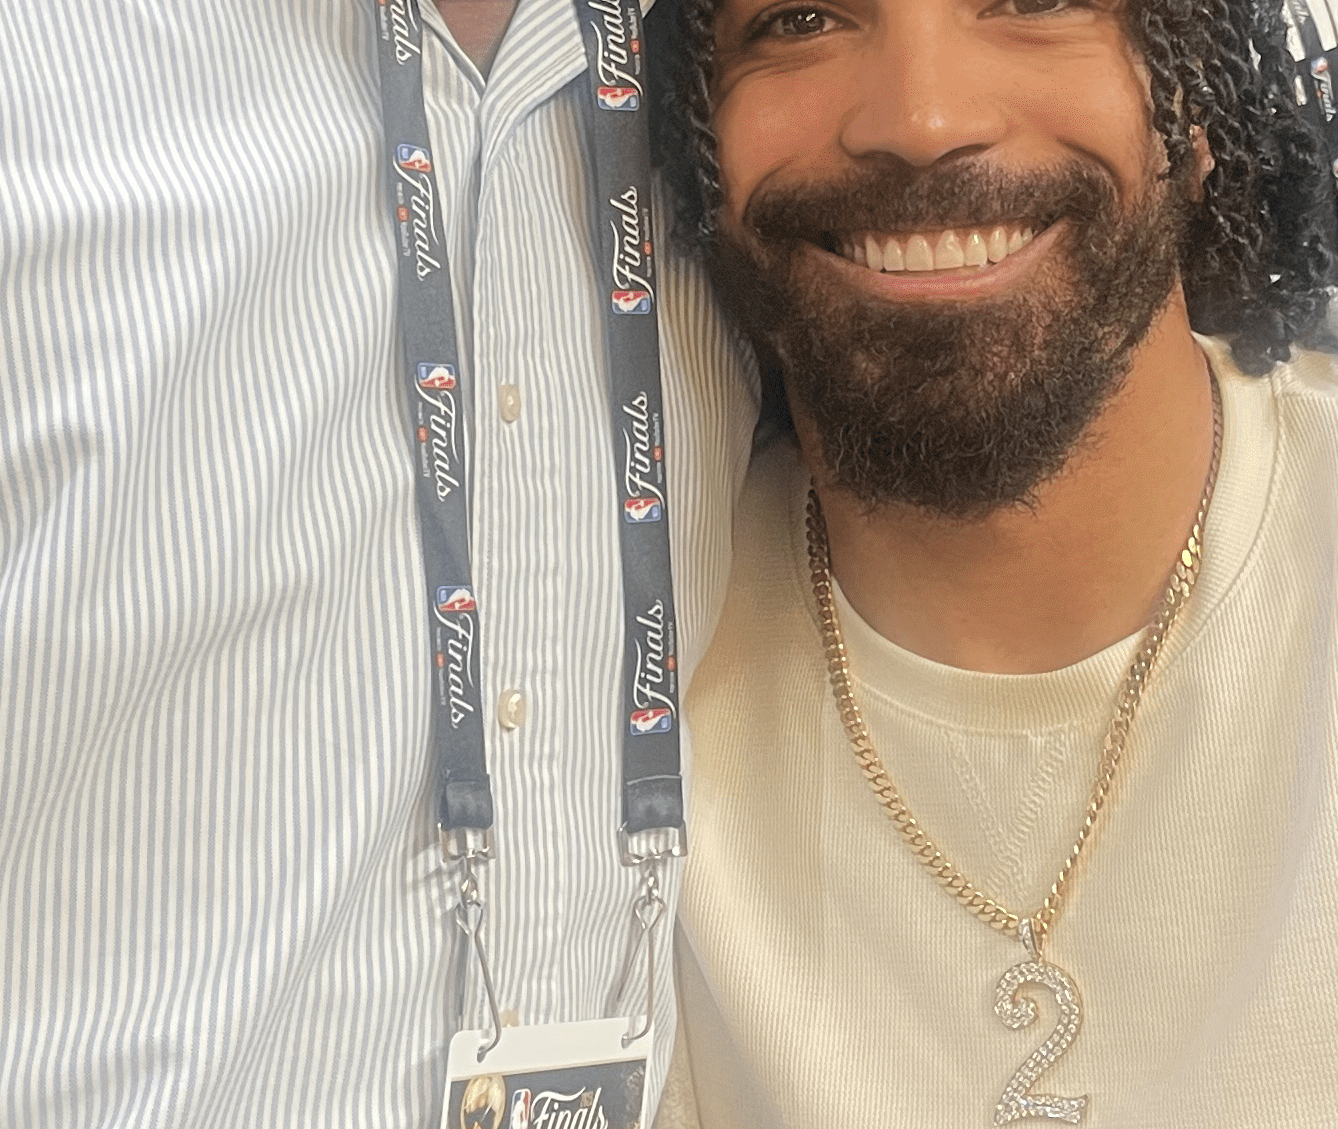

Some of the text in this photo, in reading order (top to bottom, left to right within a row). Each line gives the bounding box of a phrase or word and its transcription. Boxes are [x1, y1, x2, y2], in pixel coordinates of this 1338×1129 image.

[392, 154, 441, 282] Finals
[608, 185, 654, 304] Finals
[413, 373, 460, 503] Finals
[622, 391, 665, 509] Finals
[433, 600, 475, 729] Finals
[633, 598, 676, 719] Finals
[994, 961, 1088, 1126] 2
[530, 1086, 609, 1129] Finals
